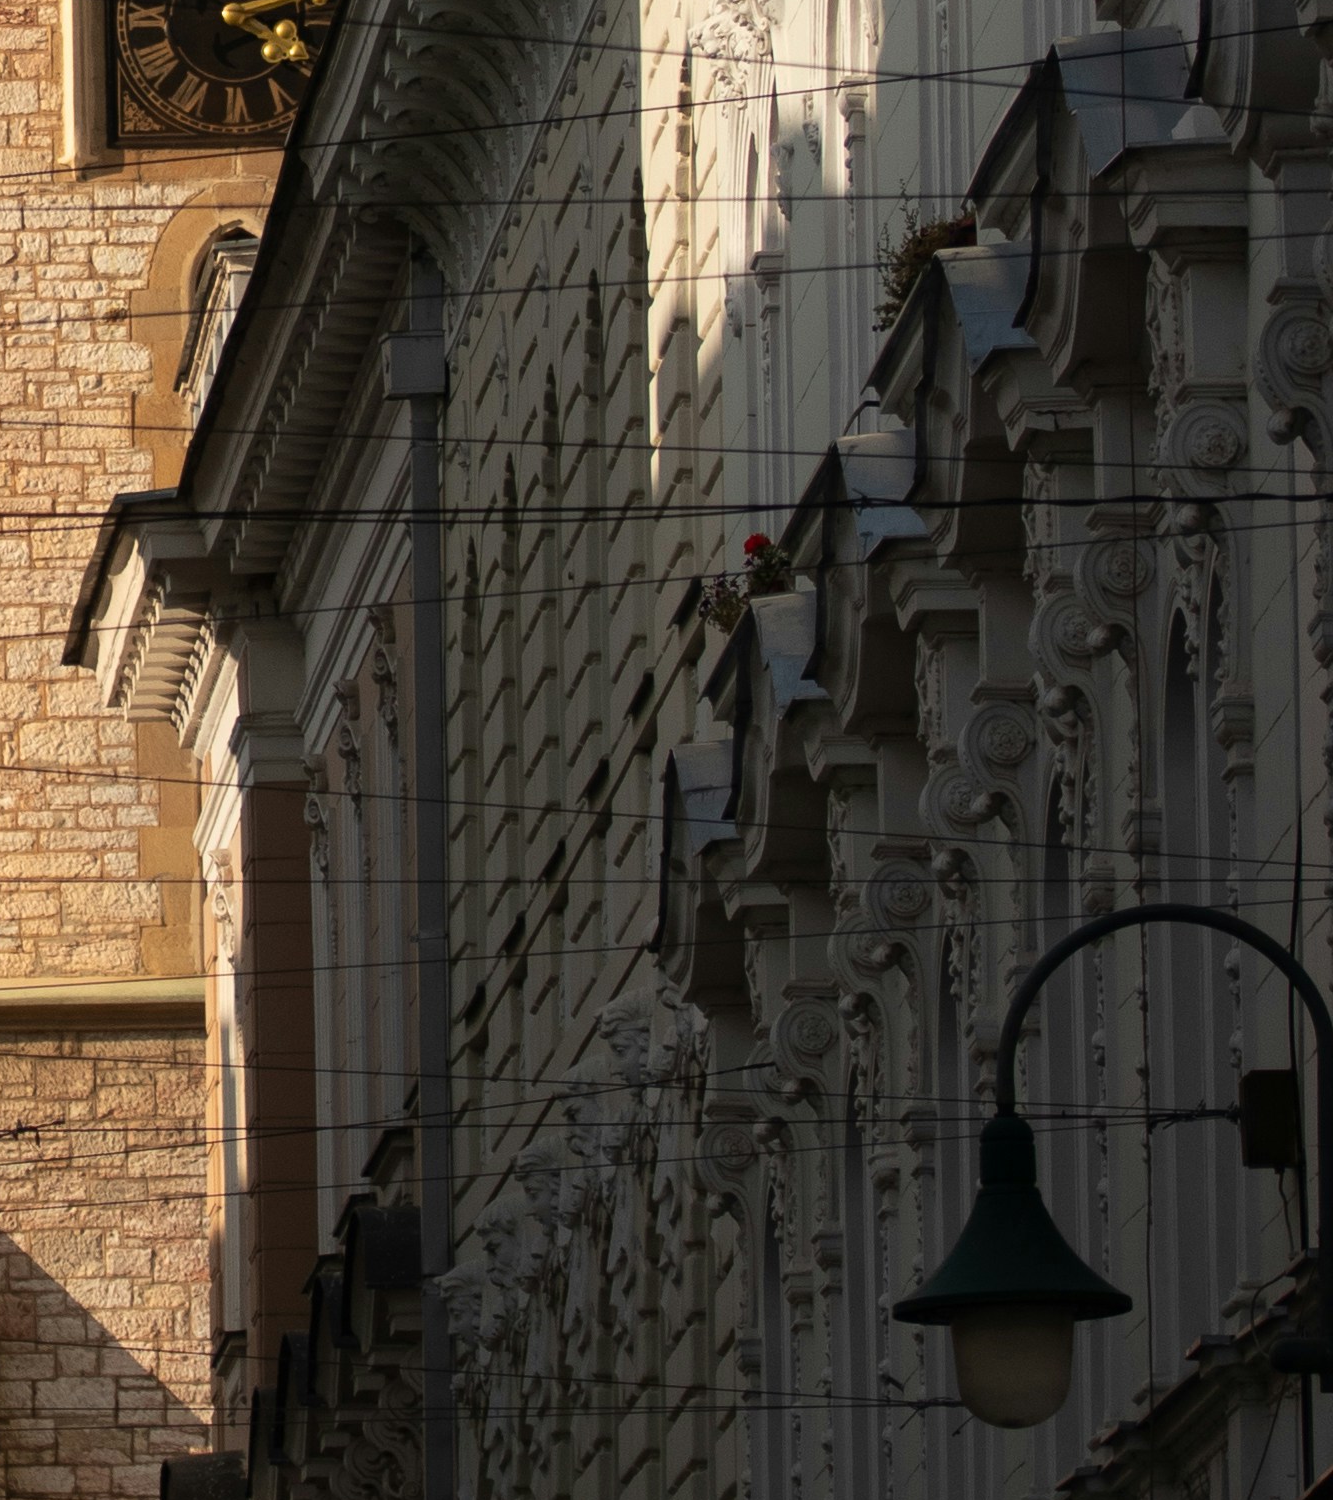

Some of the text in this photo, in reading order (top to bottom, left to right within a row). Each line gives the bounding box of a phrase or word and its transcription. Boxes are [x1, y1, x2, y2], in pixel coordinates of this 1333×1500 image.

[128, 1, 167, 31] IX
[133, 39, 181, 92] VIII
[168, 70, 210, 119] VII
[223, 86, 254, 124] VI
[267, 77, 299, 116] V
